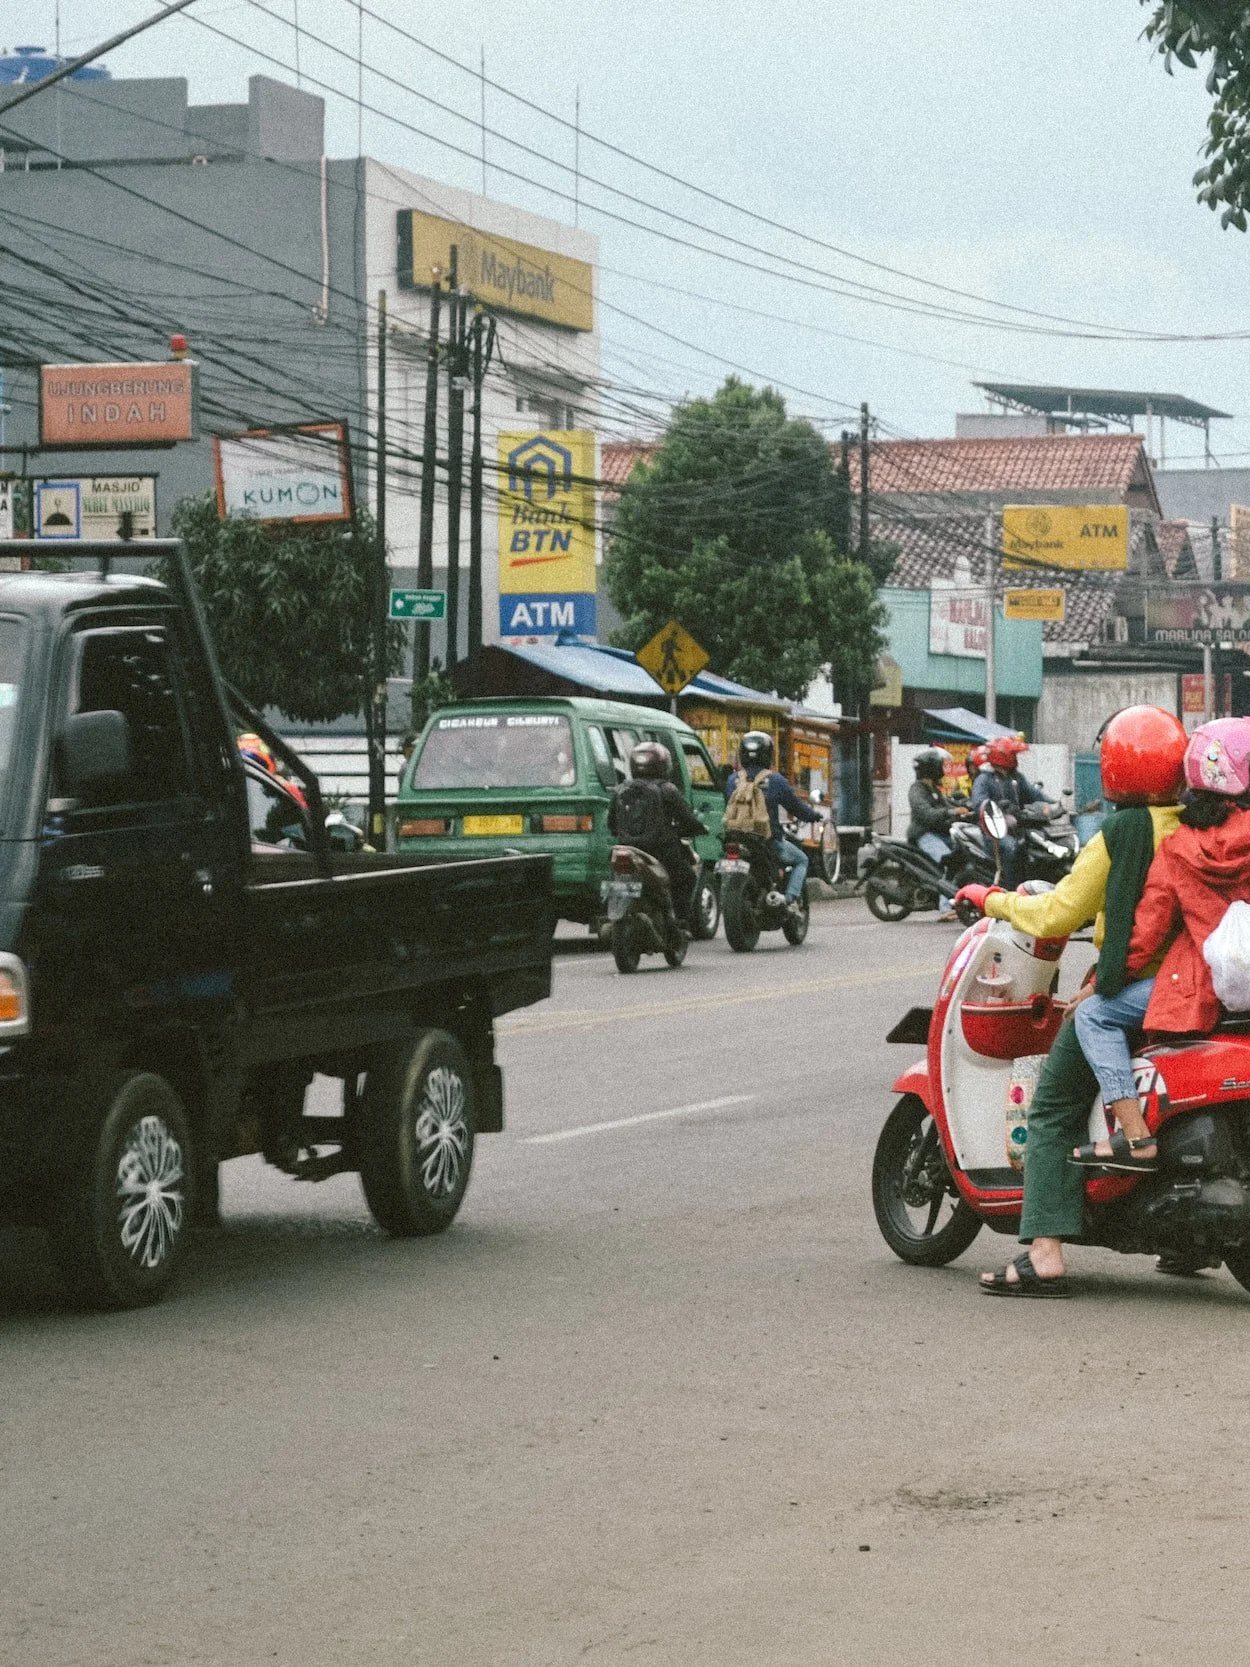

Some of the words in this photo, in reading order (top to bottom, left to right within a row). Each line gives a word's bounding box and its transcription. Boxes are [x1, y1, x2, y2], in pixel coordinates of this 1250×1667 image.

[480, 249, 555, 304] Maybank
[48, 379, 184, 397] UJUNGBERUNG
[67, 401, 165, 424] INDAH
[91, 481, 140, 493] MASJID
[243, 483, 338, 504] KUMON
[511, 503, 568, 525] Bank
[510, 530, 573, 552] BTN
[1080, 524, 1119, 538] ATM
[510, 602, 575, 628] ATM
